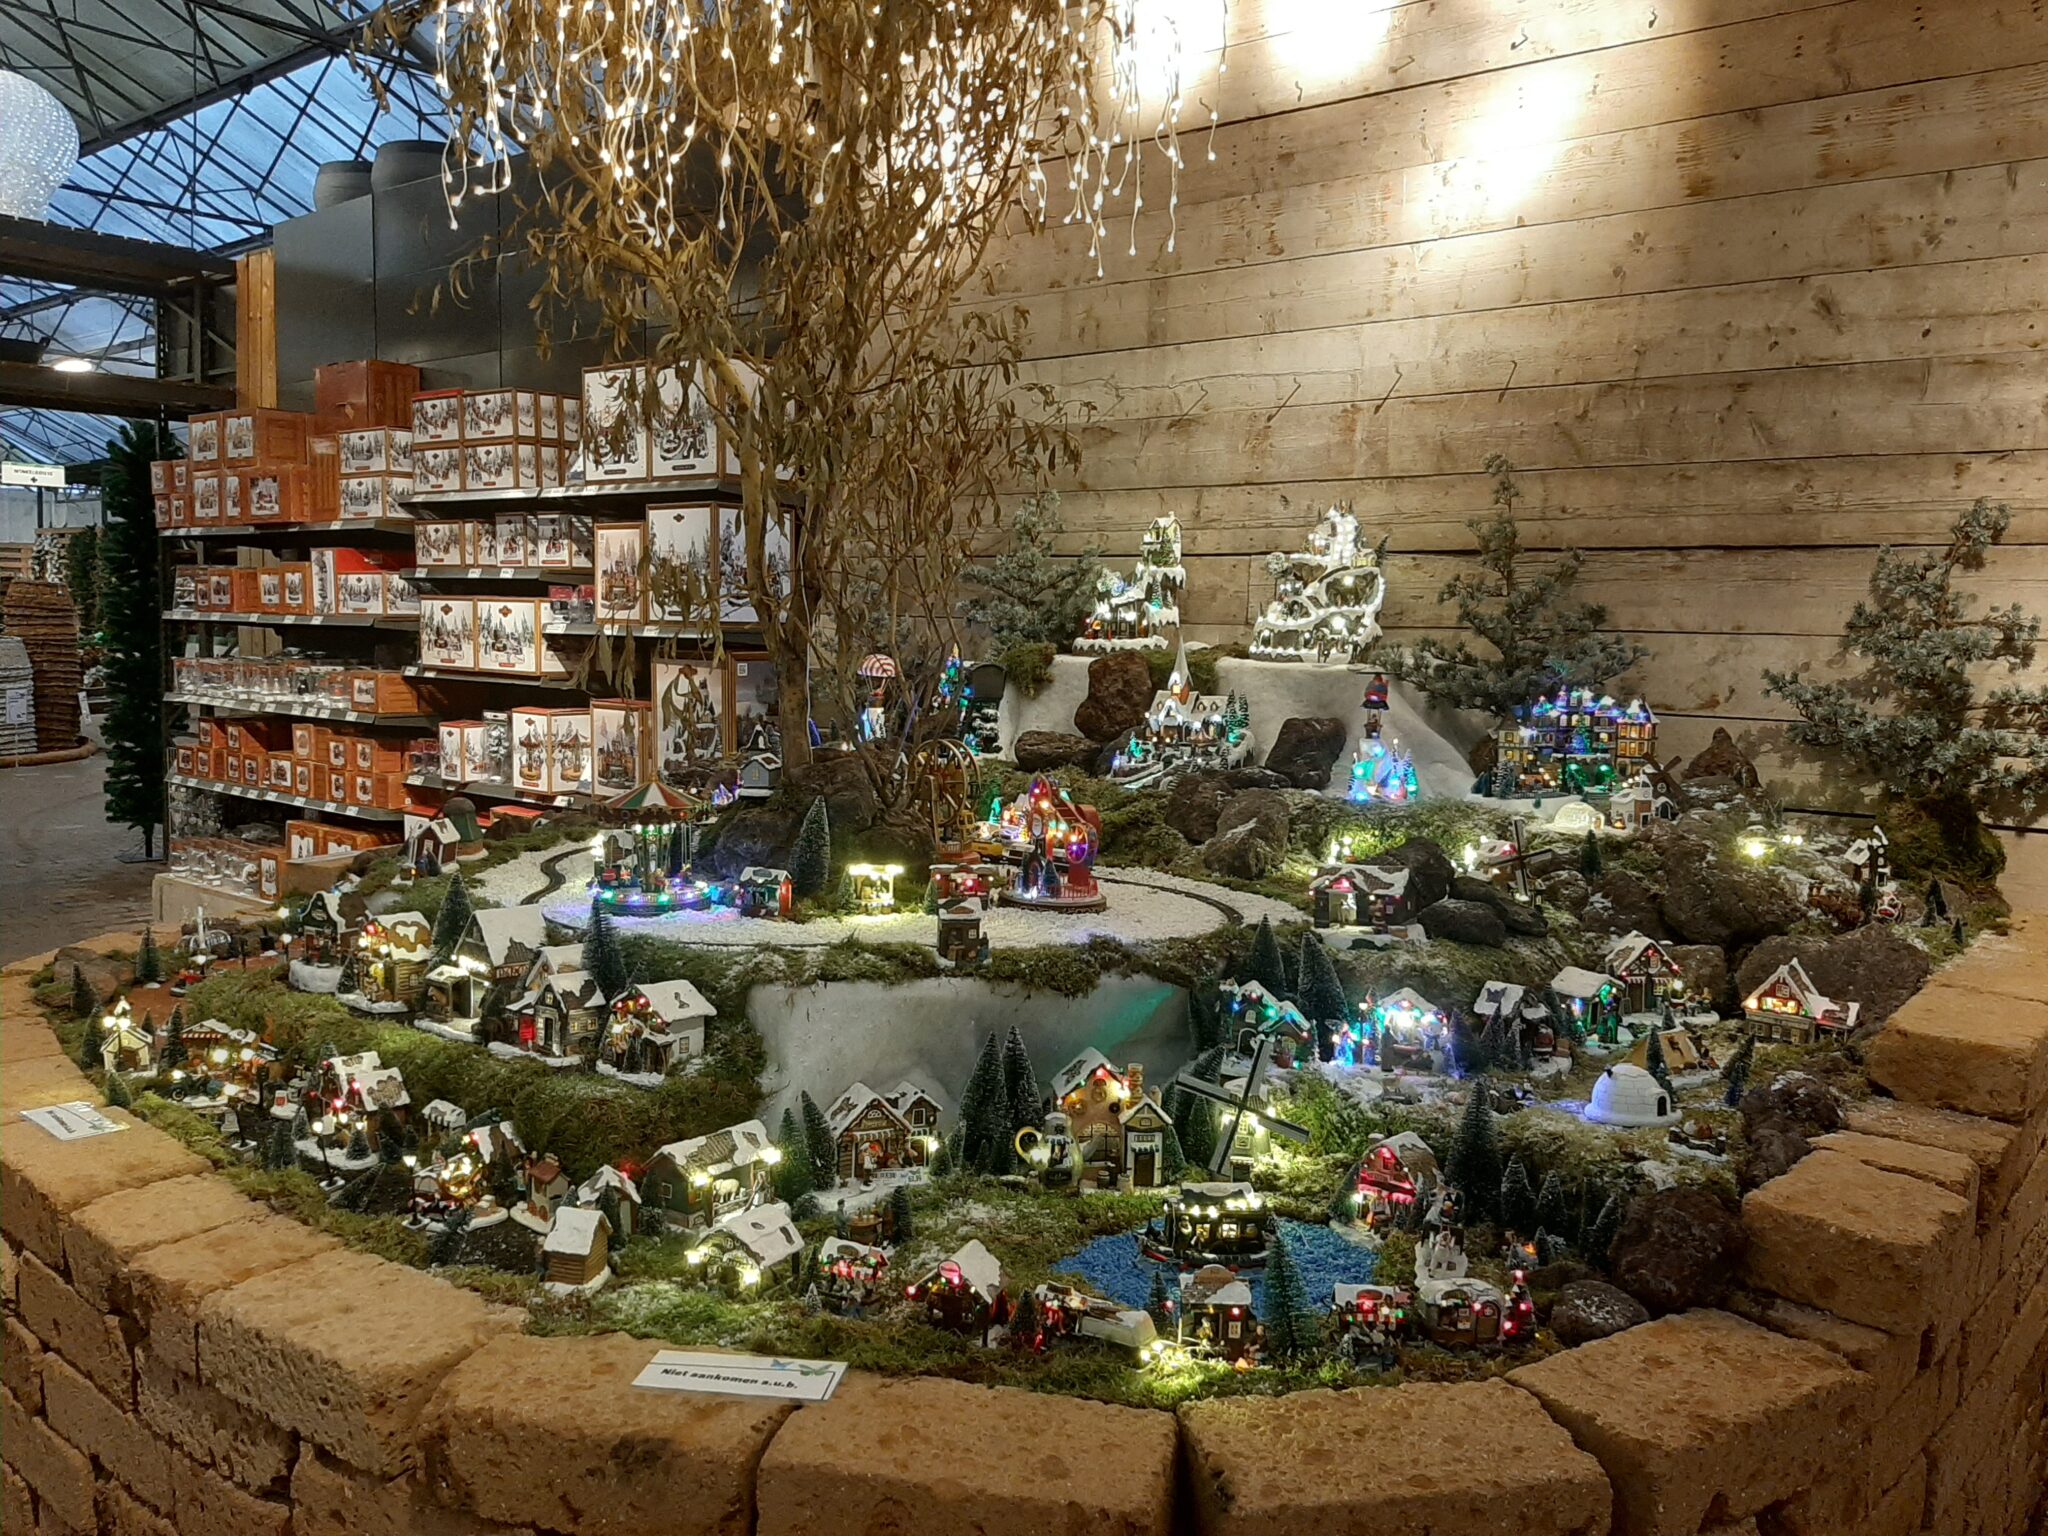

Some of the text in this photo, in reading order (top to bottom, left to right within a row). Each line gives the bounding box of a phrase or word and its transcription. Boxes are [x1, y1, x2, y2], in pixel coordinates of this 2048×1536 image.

[660, 1368, 799, 1390] Niet aankomen a.u.b.
